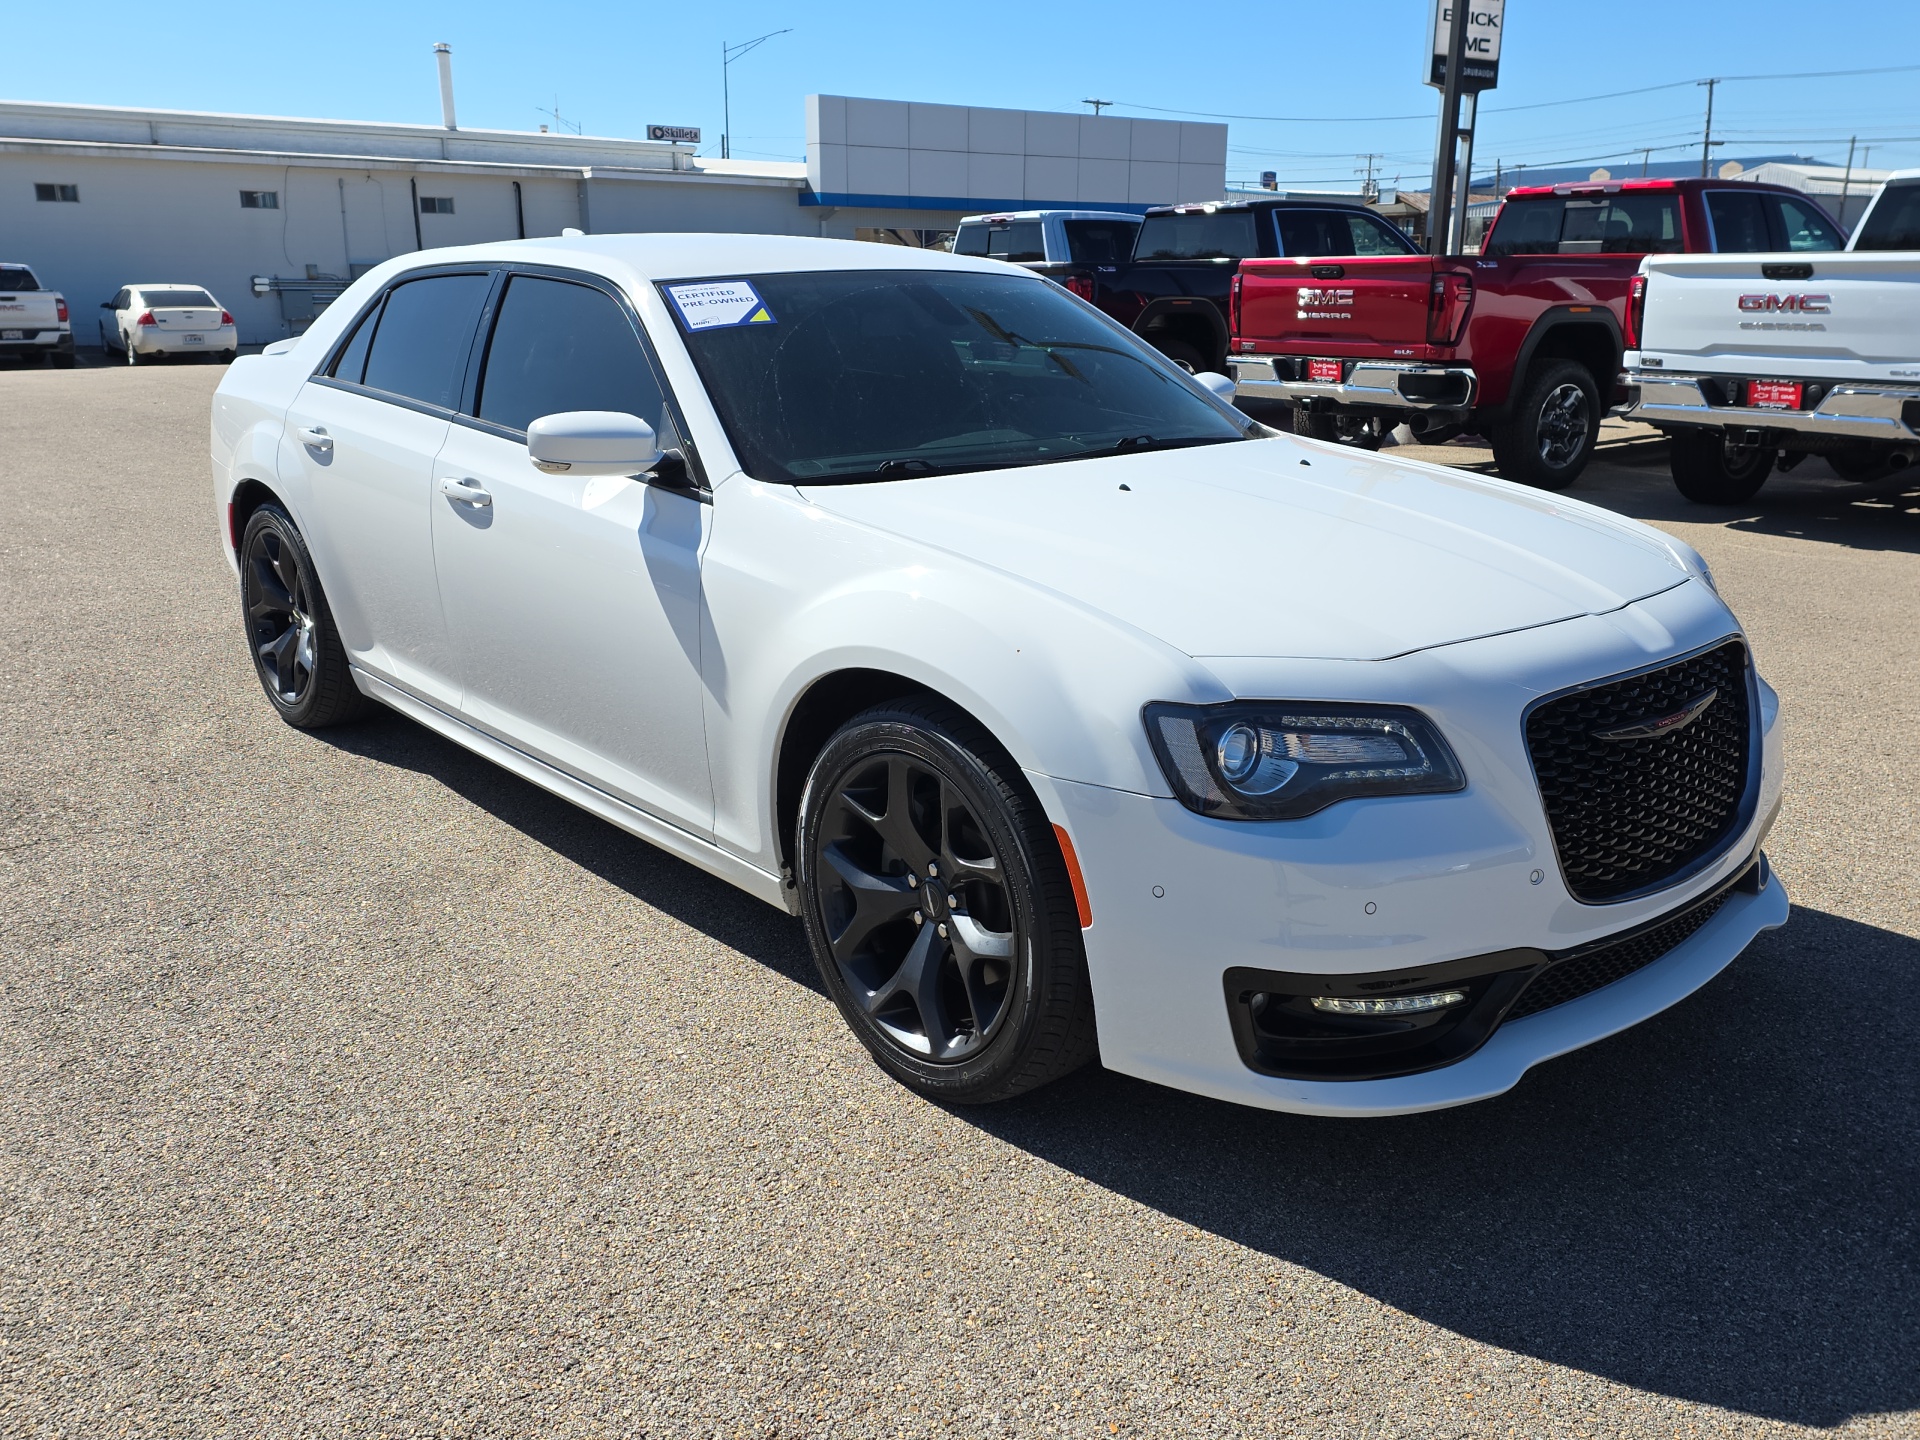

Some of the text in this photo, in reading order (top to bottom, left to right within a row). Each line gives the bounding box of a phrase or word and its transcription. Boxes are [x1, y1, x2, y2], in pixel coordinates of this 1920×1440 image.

[1443, 8, 1499, 28] BICK
[664, 128, 698, 139] Skillets
[677, 289, 735, 300] CERTIFIED
[1297, 288, 1353, 305] GMC
[682, 296, 754, 308] PRE-OWNED
[1738, 294, 1831, 313] GMC
